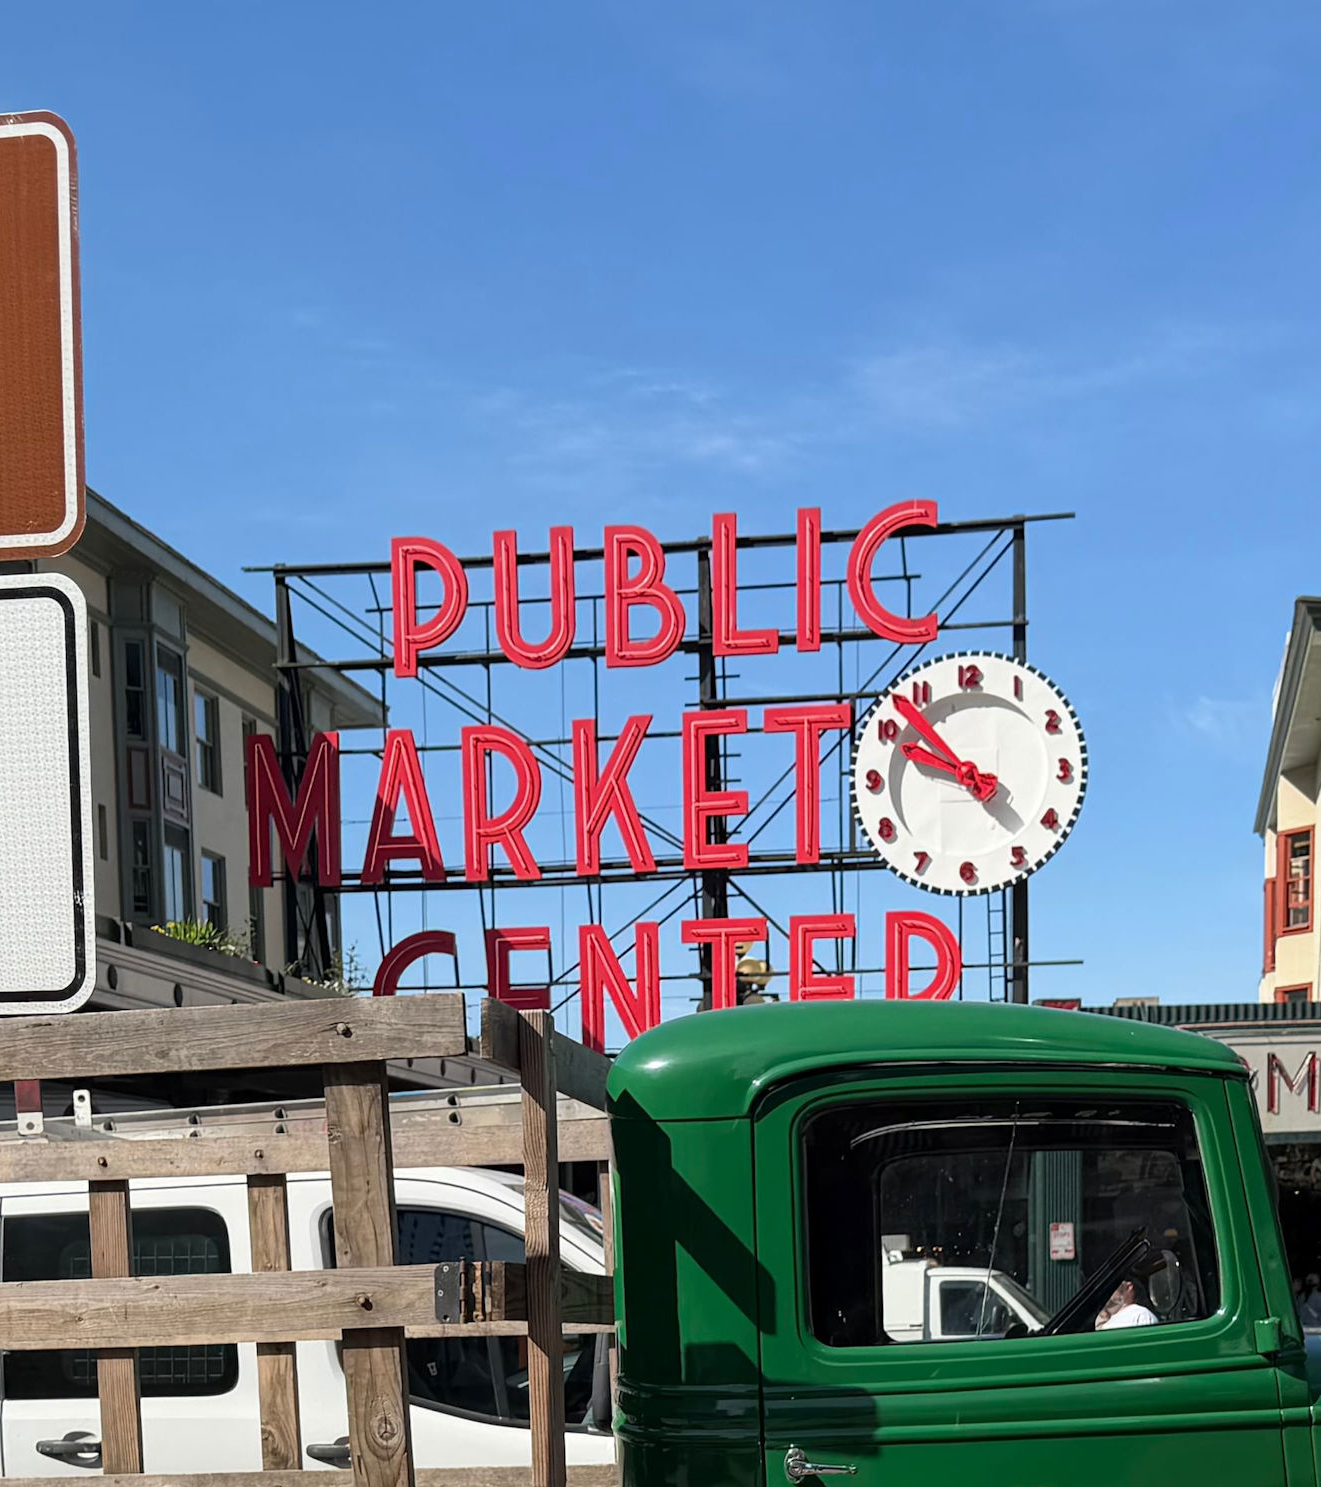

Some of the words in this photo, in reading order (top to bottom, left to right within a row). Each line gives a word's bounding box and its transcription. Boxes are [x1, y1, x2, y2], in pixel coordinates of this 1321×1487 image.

[391, 498, 938, 678] PUBLIC
[958, 664, 981, 688] 12
[913, 680, 930, 704] 11
[878, 719, 898, 741] 10
[1044, 709, 1059, 733] 2
[865, 769, 881, 791] 9
[1056, 758, 1070, 780] 3
[247, 703, 853, 888] MARKET
[878, 817, 893, 839] 8
[1040, 808, 1059, 829] 4
[913, 851, 928, 873] 7
[1010, 846, 1027, 867] 5
[959, 861, 978, 882] 6
